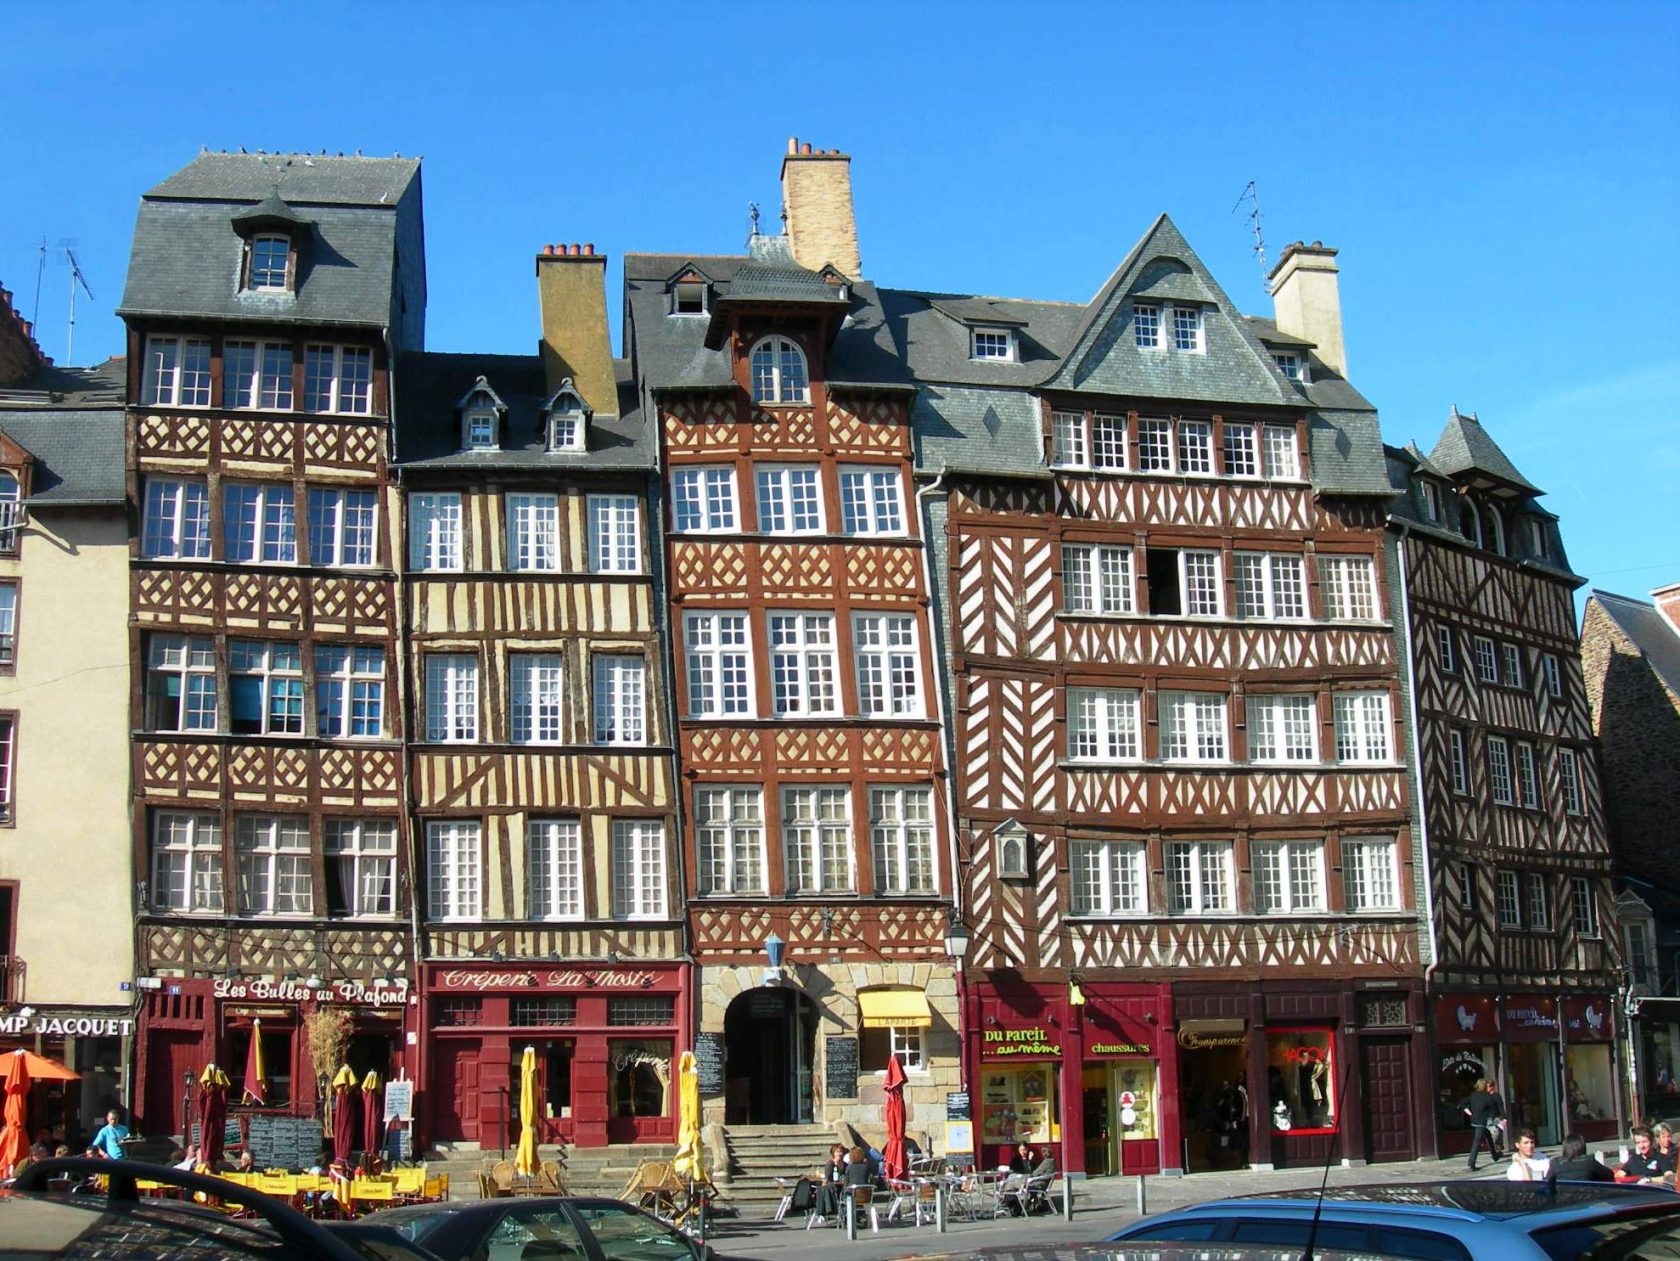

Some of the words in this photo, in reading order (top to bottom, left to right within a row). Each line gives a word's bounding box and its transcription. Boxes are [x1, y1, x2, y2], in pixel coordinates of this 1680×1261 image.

[442, 970, 539, 991] Crêperie
[547, 970, 583, 986] La
[214, 979, 247, 998] Les
[250, 981, 310, 1001] Bulles
[316, 991, 334, 1001] au
[339, 983, 407, 1007] Plafond
[35, 1017, 132, 1036] JACQUET
[1091, 1042, 1150, 1053] chaussures
